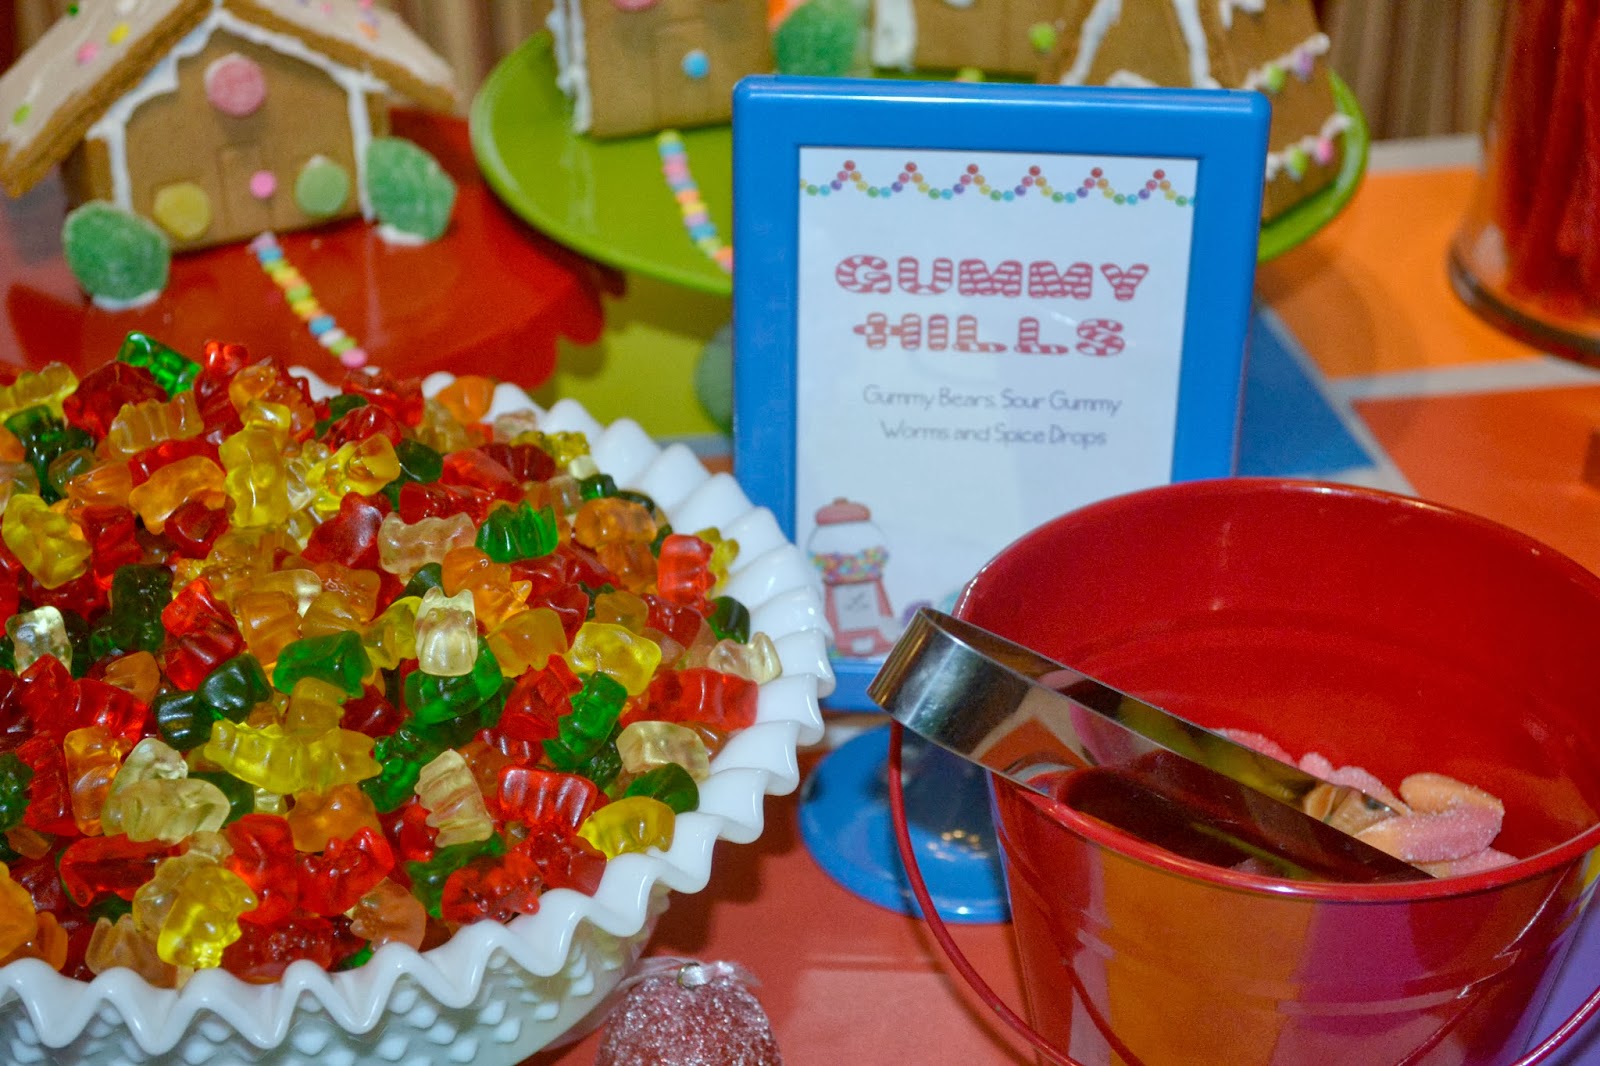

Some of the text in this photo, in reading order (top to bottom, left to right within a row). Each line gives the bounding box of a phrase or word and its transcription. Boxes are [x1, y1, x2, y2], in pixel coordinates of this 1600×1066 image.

[835, 254, 1150, 302] GUMMY
[853, 313, 1126, 357] HILLS
[863, 384, 934, 411] Gummy
[1000, 388, 1046, 410] Sour
[1049, 390, 1123, 417] Gummy
[880, 419, 1108, 450] Worms and Spice Drops
